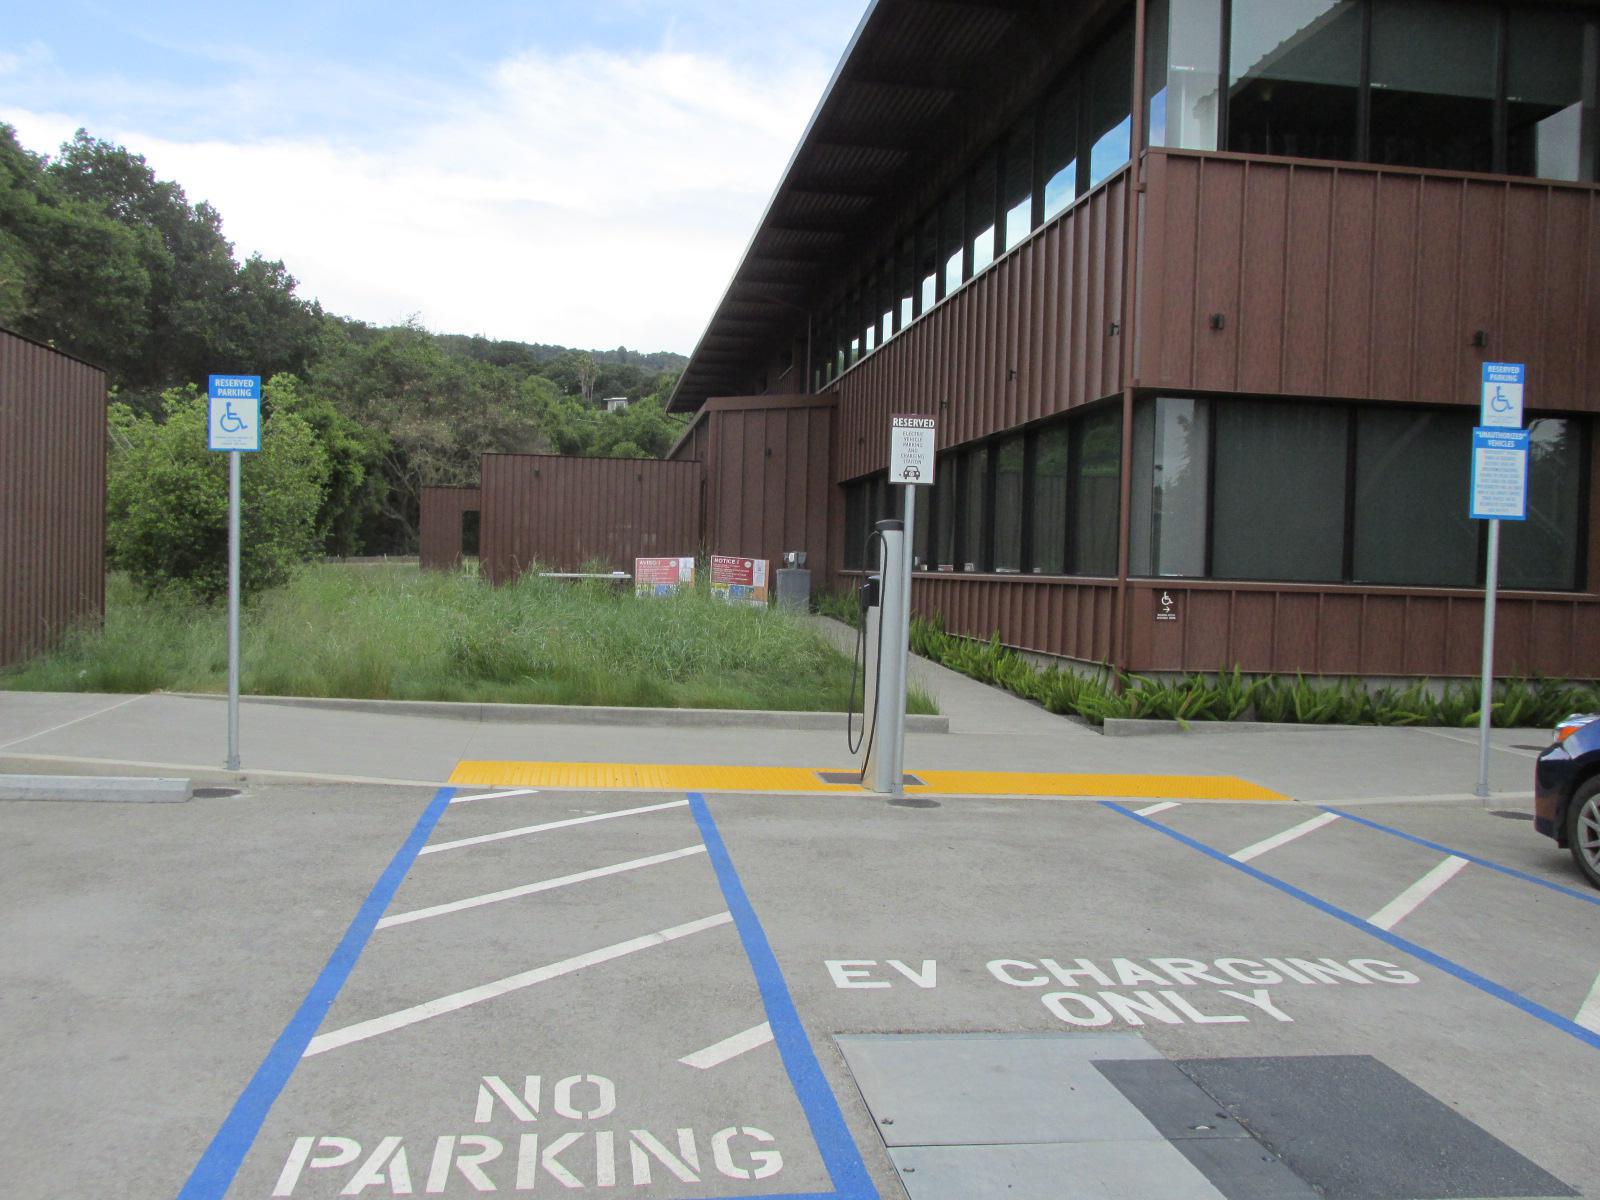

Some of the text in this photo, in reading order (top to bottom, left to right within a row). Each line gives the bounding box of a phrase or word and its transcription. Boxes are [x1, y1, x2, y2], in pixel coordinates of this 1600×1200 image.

[215, 378, 254, 387] RESERVED
[217, 388, 252, 397] PARKING
[893, 417, 935, 428] RESERVED
[824, 958, 1421, 989] EV CHARGING
[1041, 989, 1294, 1026] ONLY
[475, 1074, 616, 1123] NO
[271, 1126, 783, 1197] PARKING
